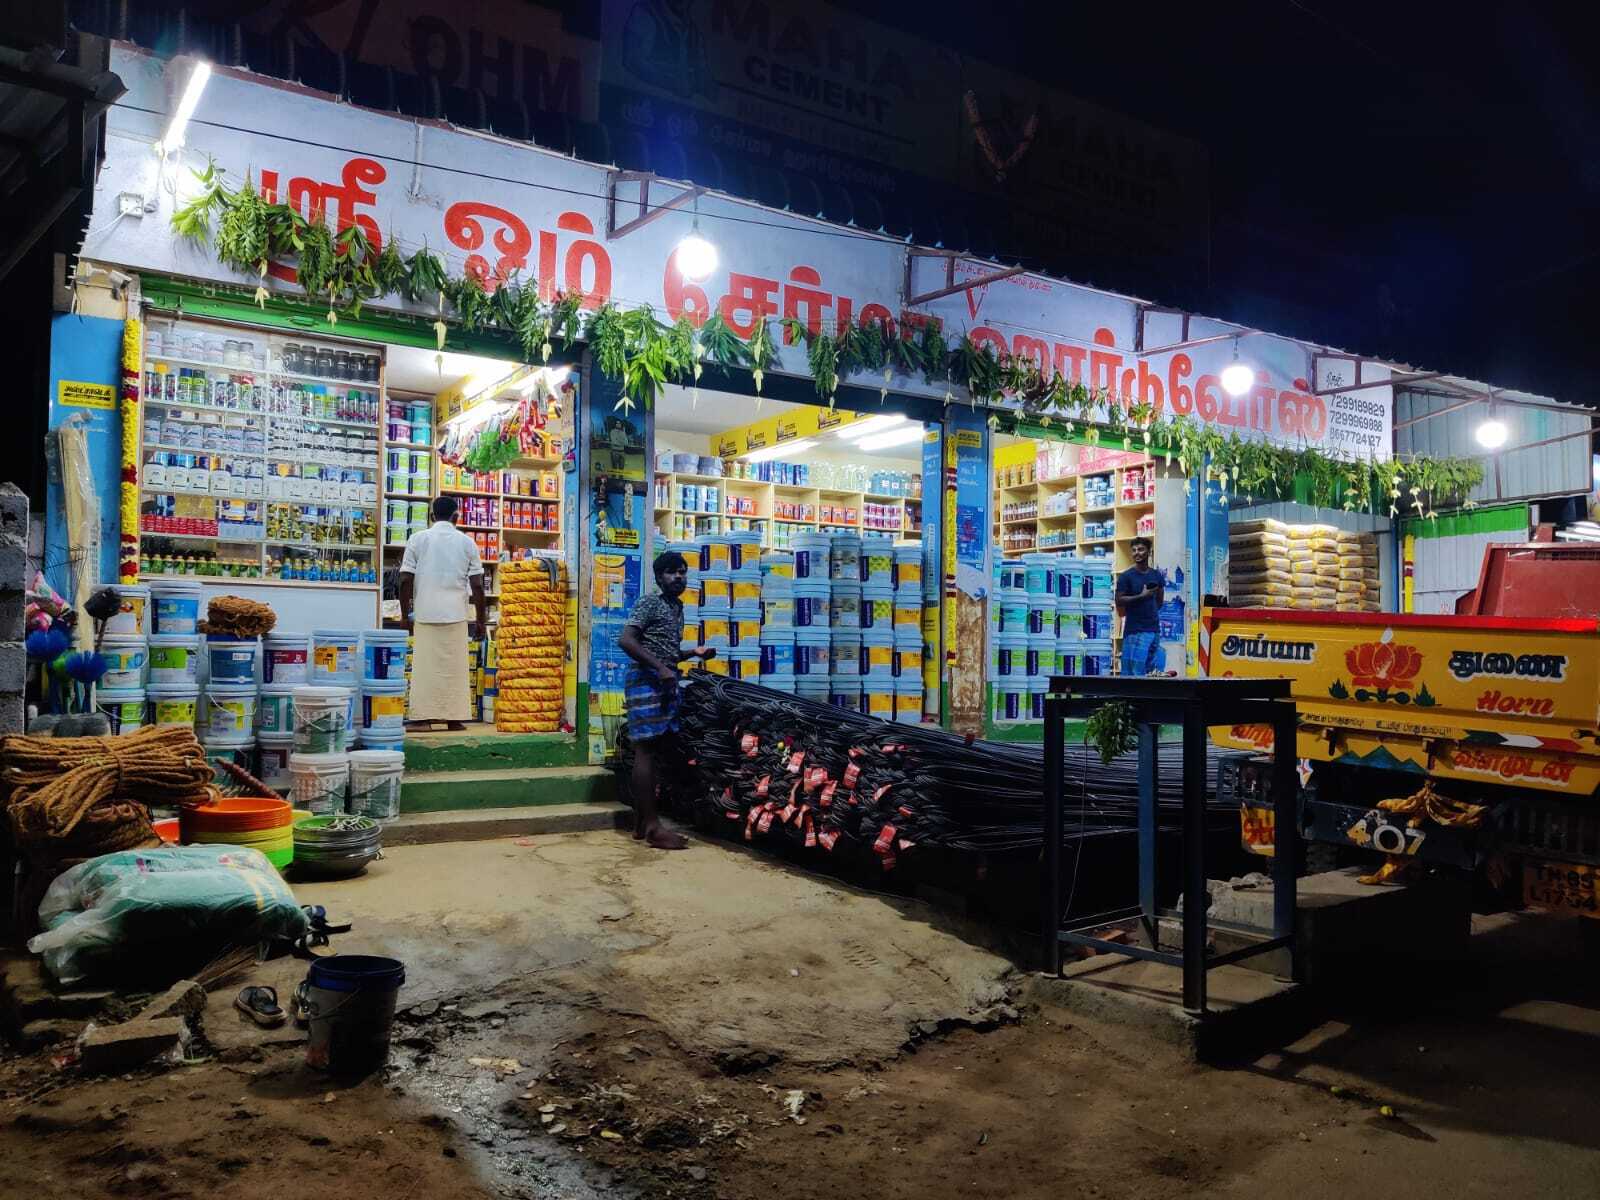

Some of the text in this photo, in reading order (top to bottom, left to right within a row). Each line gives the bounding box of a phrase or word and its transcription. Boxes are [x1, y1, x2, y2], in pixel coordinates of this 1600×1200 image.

[743, 53, 892, 123] CEMENT
[1330, 393, 1385, 417] 7299189829
[1329, 410, 1383, 432] 7299969888
[1221, 633, 1566, 679] அய்யா துணை
[1476, 689, 1555, 716] Horn
